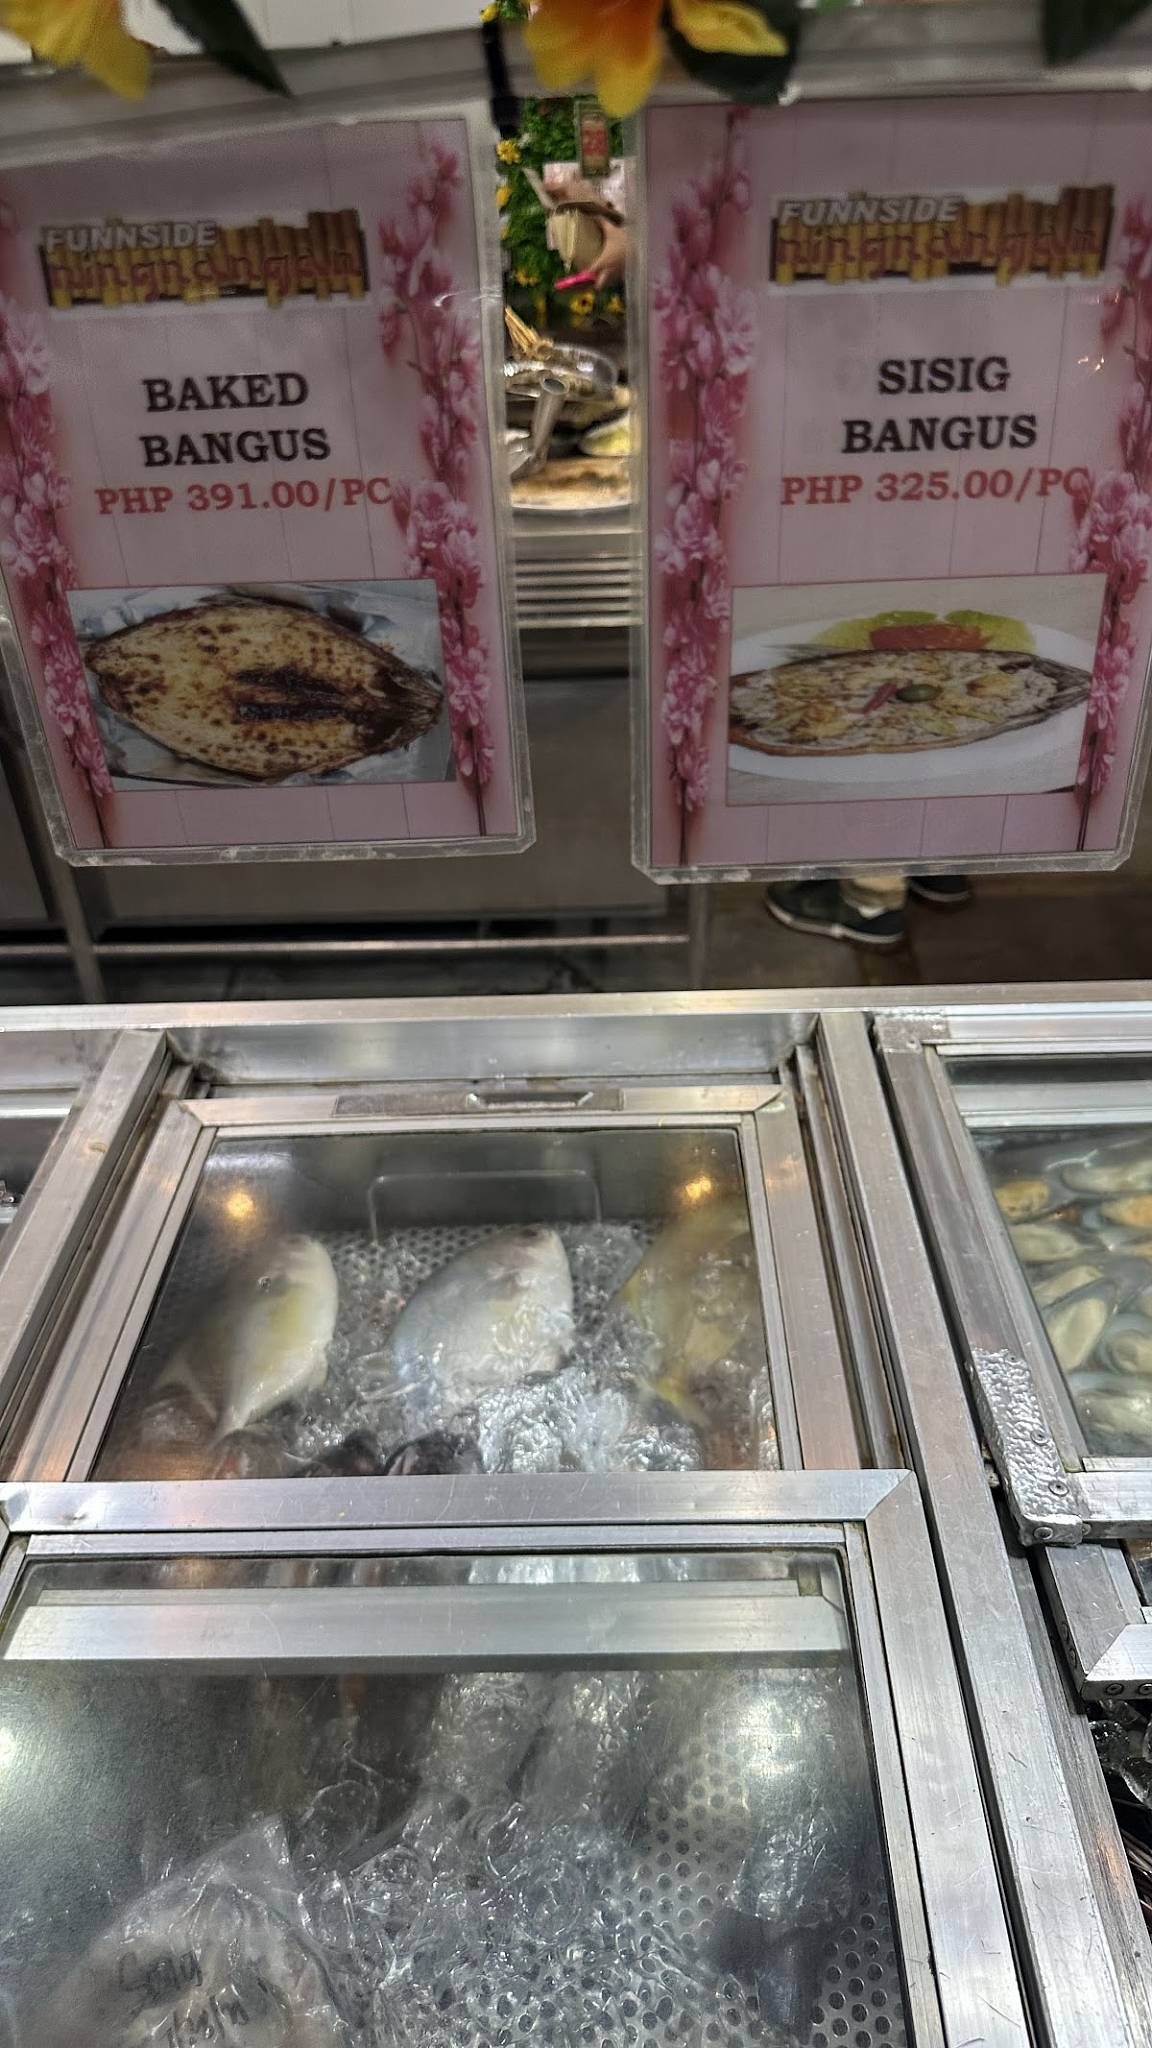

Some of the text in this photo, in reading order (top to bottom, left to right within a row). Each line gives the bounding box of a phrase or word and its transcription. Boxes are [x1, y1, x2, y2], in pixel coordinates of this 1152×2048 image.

[780, 195, 963, 226] FUNNSIDE
[44, 222, 217, 252] FUNNSIDE
[142, 373, 310, 412] BAKED
[877, 357, 1010, 394] SISIG
[138, 429, 331, 467] BANGUS
[841, 415, 1038, 454] BANGUS
[95, 476, 391, 515] PHP 391.00/PC
[781, 466, 1092, 505] PHP 325.00/PC
